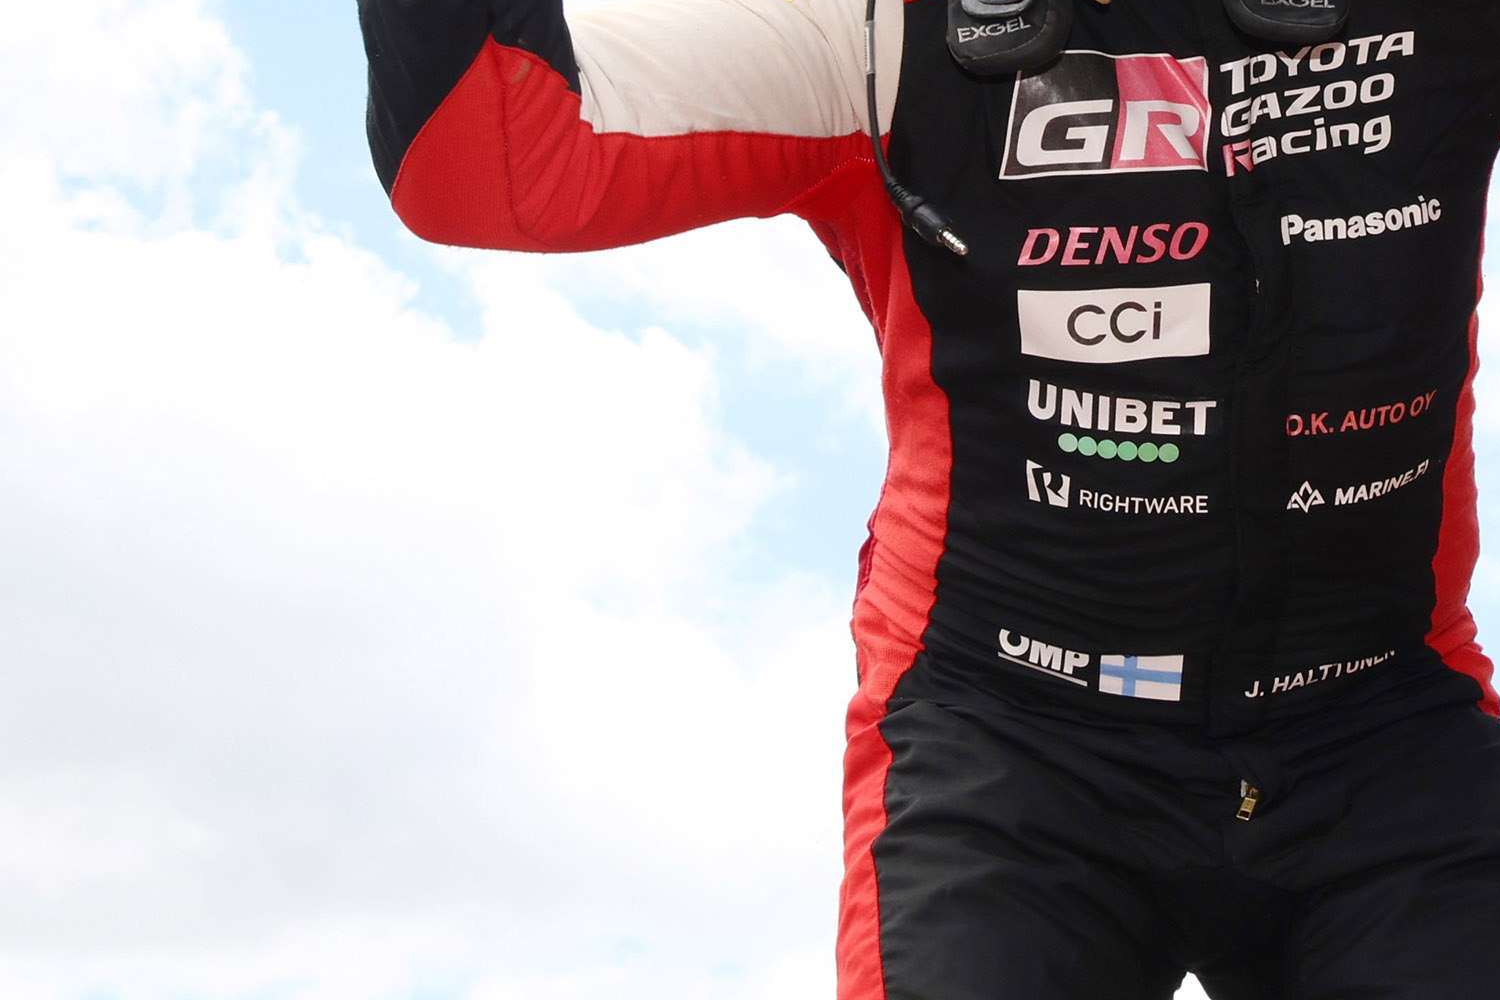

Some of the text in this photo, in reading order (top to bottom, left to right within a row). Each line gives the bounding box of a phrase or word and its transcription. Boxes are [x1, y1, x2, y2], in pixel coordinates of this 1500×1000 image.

[957, 16, 1031, 43] EXGEL
[1219, 30, 1415, 96] TOYOTA
[1220, 72, 1396, 137] GAZOO
[1016, 98, 1201, 167] GR
[1222, 114, 1393, 178] Racing
[1016, 221, 1210, 266] DENSO
[1280, 194, 1443, 246] Panasonic
[1026, 378, 1218, 436] UNIBET
[1285, 389, 1438, 437] O.K. AUTO OY
[1078, 488, 1209, 515] RIGHTWARE
[1334, 458, 1430, 506] MARINE.FI
[1244, 680, 1265, 698] J.
